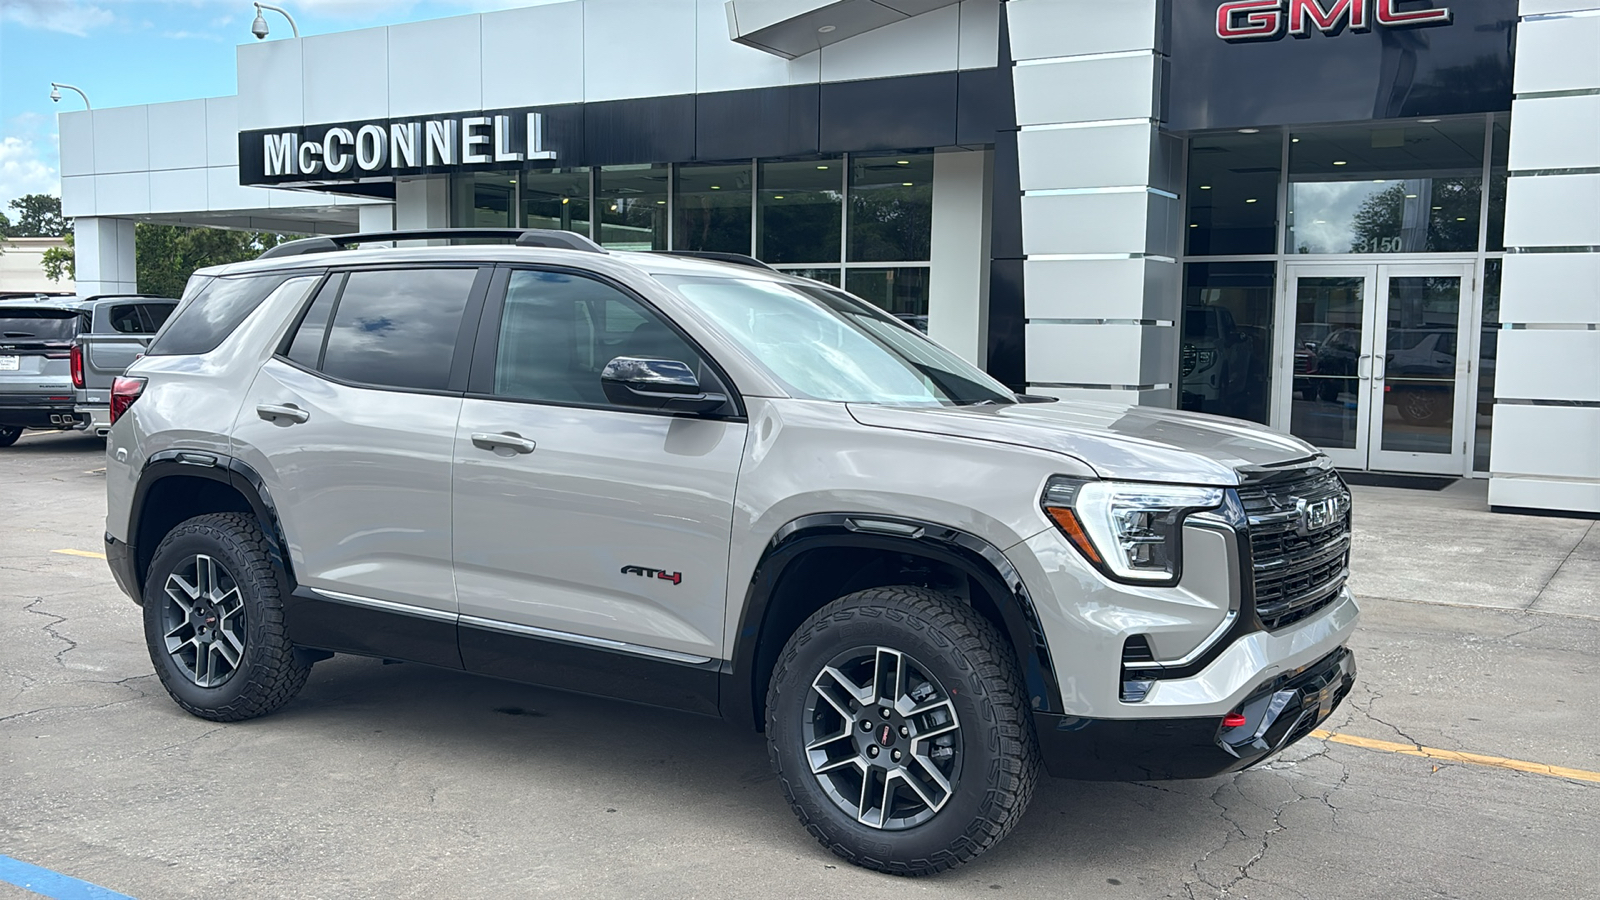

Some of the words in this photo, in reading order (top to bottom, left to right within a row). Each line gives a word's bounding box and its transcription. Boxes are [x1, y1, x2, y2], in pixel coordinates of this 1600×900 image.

[1215, 0, 1452, 42] GMC
[263, 112, 557, 176] McCONNELL
[1358, 236, 1403, 253] 3150
[620, 564, 682, 586] AT4
